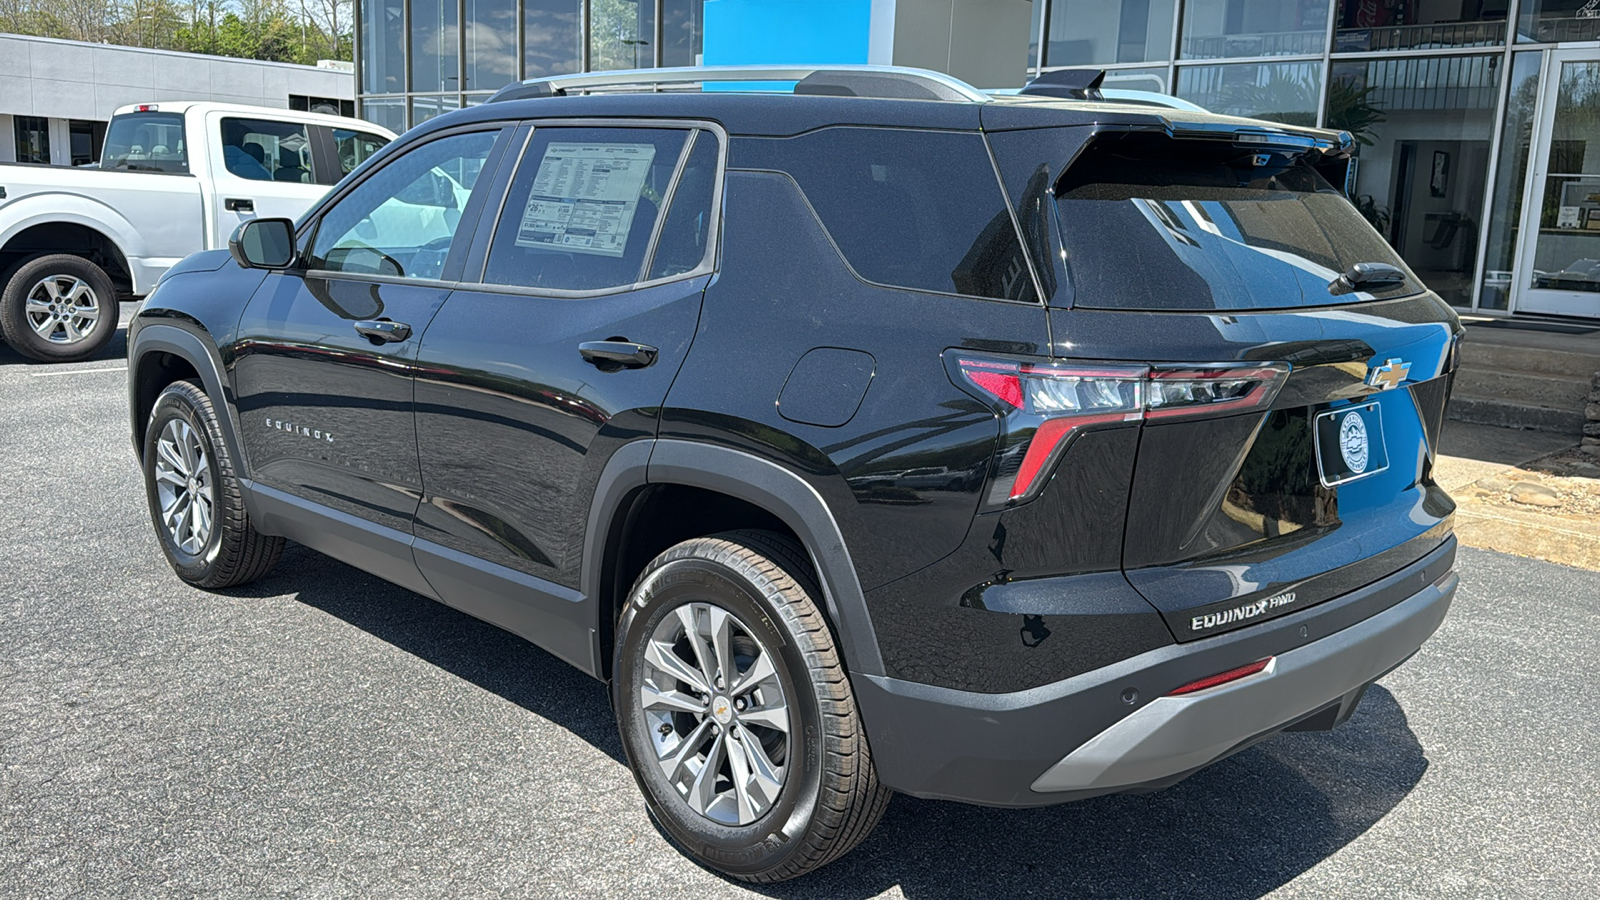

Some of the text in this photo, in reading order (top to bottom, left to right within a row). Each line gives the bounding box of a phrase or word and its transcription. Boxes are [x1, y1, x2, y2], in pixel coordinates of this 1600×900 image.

[265, 418, 334, 443] EQUINOX
[1191, 592, 1297, 631] EQUINOX AWD
